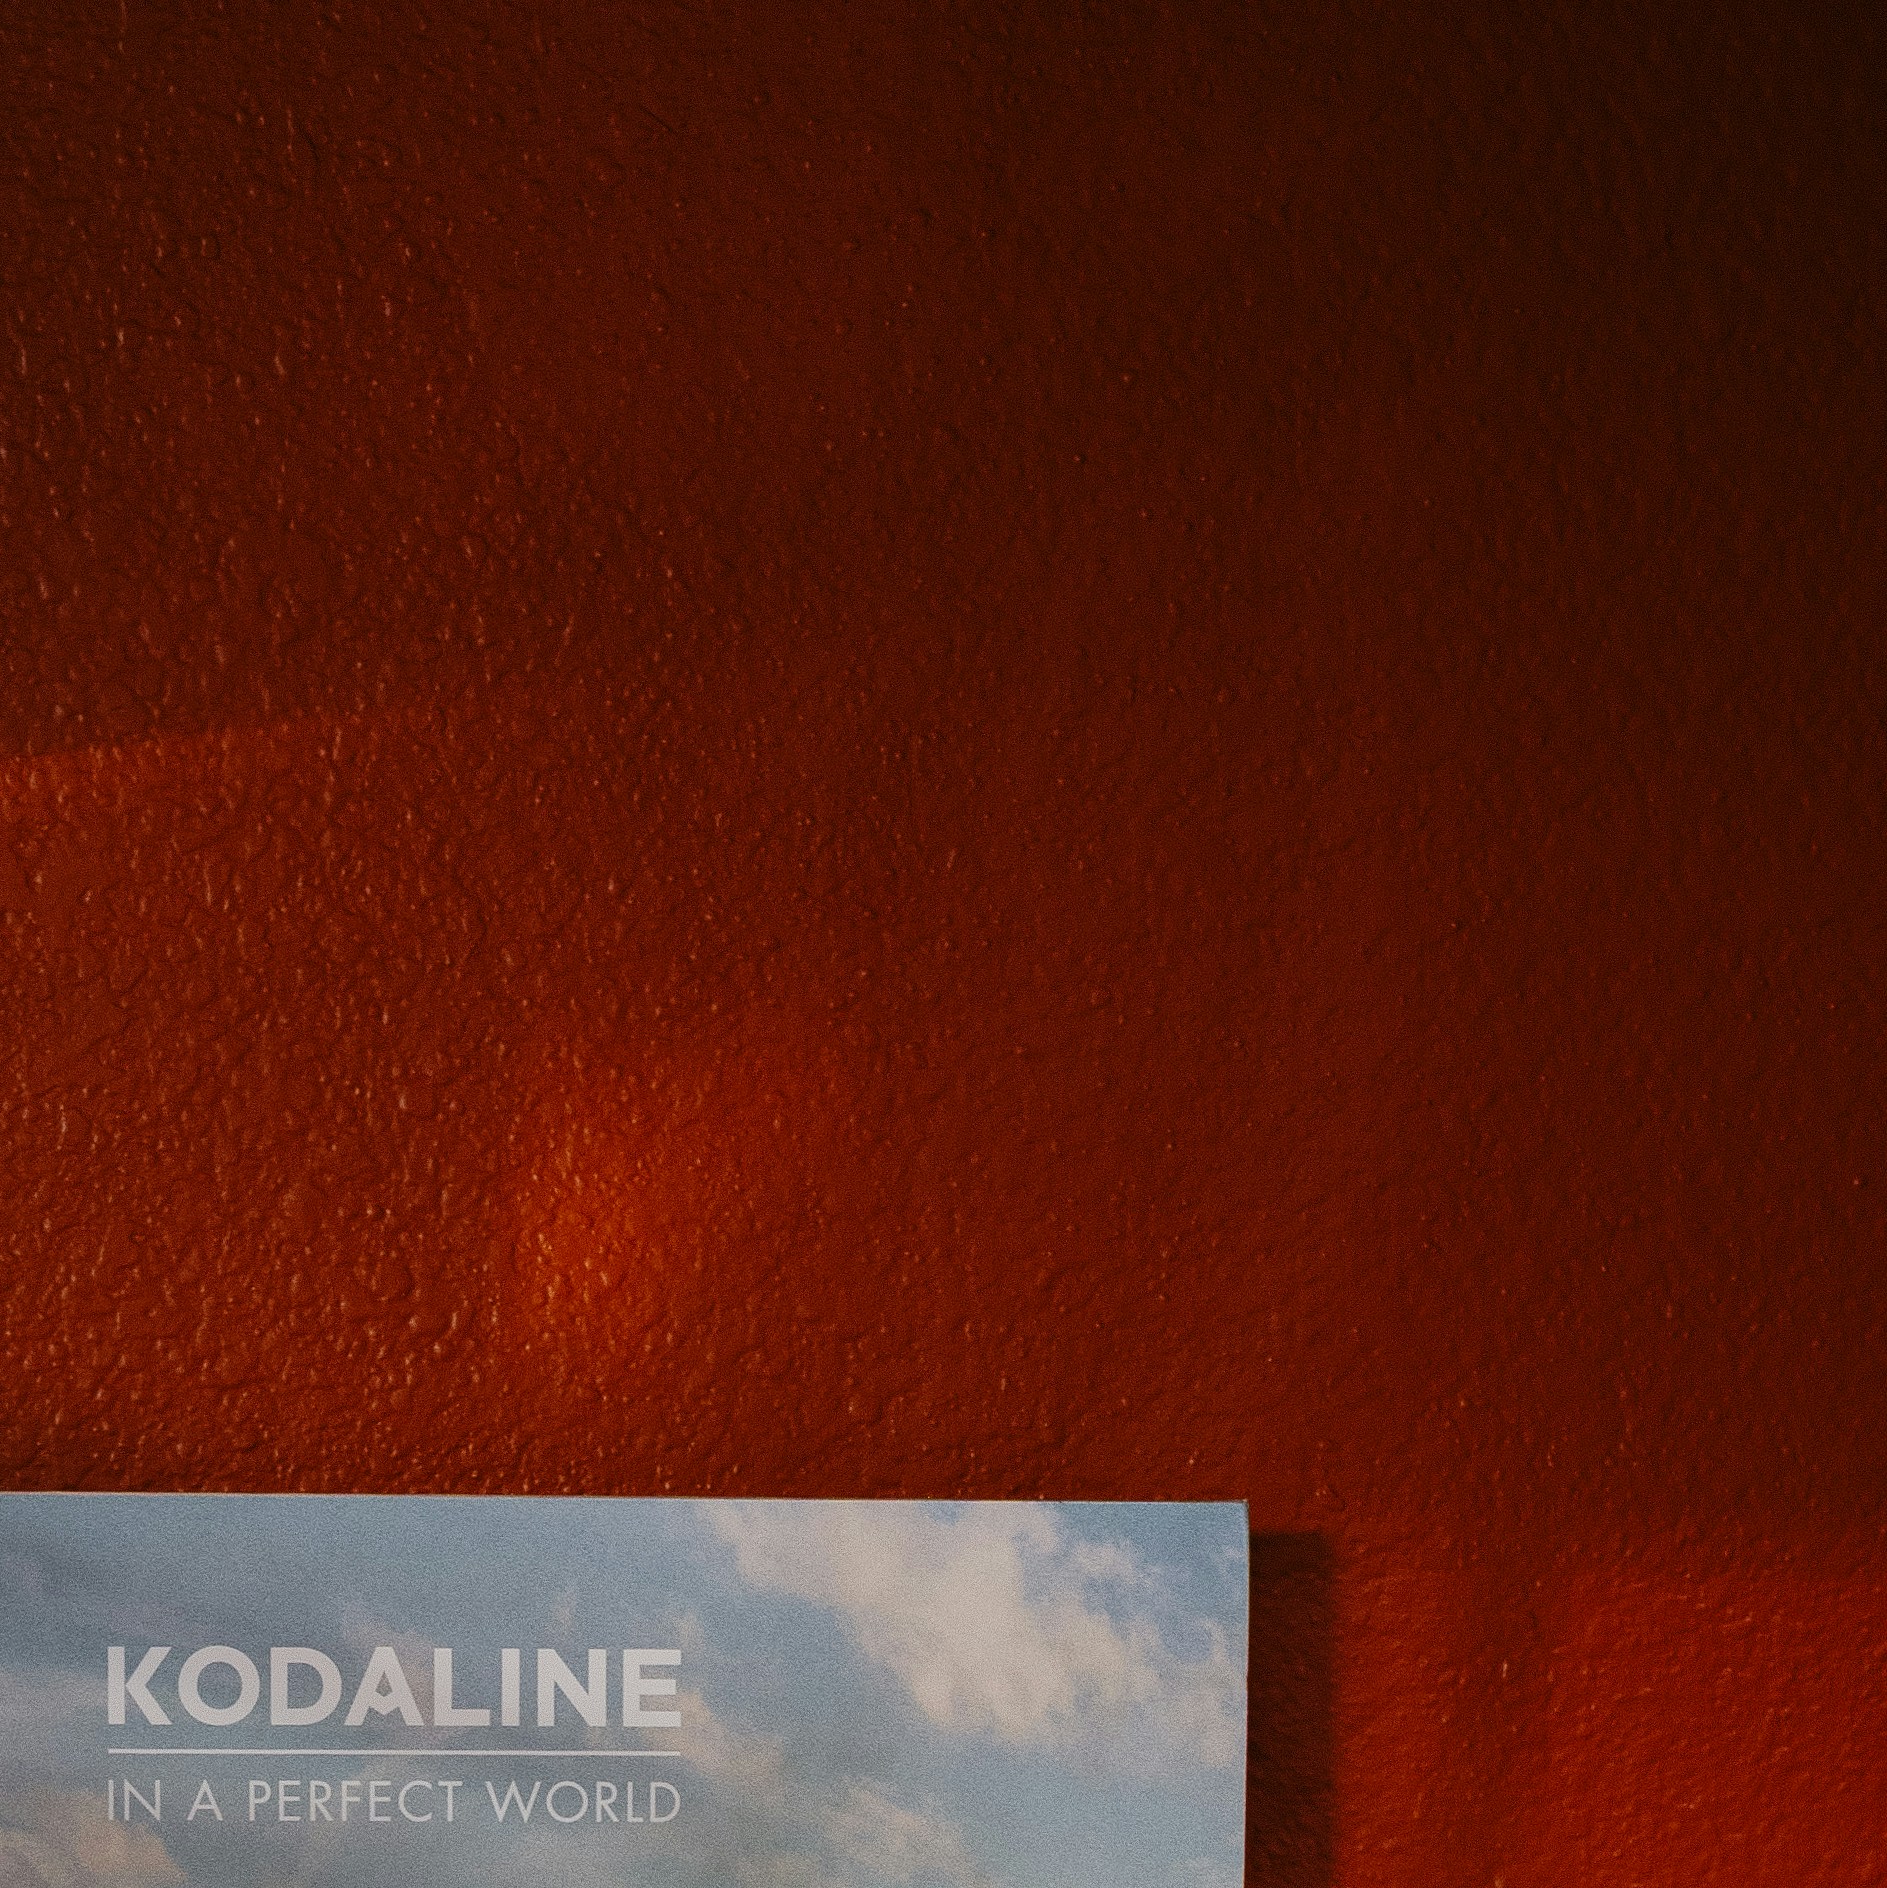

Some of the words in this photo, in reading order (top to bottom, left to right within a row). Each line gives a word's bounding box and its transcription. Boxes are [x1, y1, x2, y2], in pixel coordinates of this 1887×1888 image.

[106, 1645, 683, 1728] KODALINE
[108, 1779, 162, 1822] IN
[186, 1779, 224, 1822] A
[248, 1779, 464, 1823] PERFECT
[486, 1780, 683, 1824] WORLD
